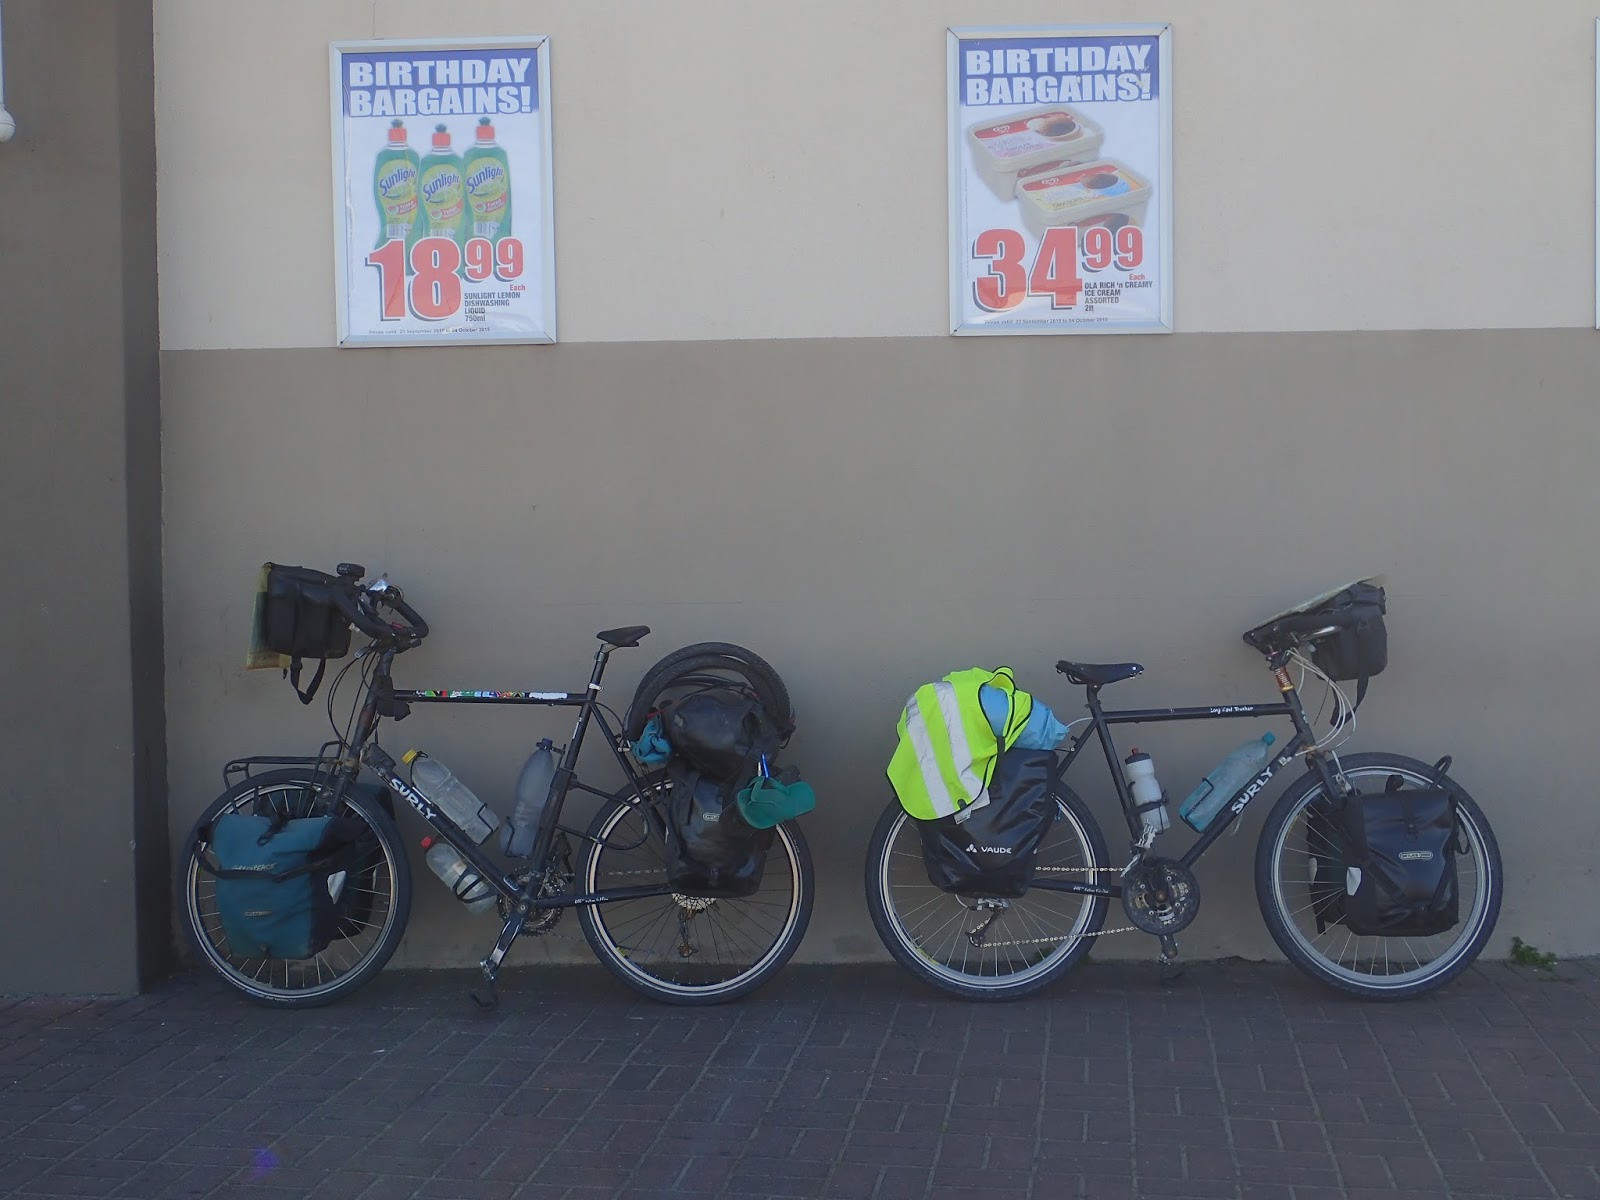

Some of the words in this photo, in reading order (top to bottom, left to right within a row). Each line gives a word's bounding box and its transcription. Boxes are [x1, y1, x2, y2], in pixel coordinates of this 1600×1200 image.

[966, 45, 1151, 75] BIRTHDAY
[350, 58, 531, 87] BIRTHDAY
[966, 73, 1151, 105] BARGAINS!
[350, 86, 533, 117] BARGAINS!
[380, 168, 416, 197] Sunlight
[423, 173, 460, 201] Sunlight
[466, 166, 504, 194] Sunlight
[1084, 282, 1098, 290] OLA
[1099, 281, 1115, 289] RICH
[1124, 280, 1153, 289] CREAMY
[1129, 273, 1146, 281] Each
[464, 292, 496, 300] SUNLIGHT
[497, 291, 521, 299] LEMON
[1084, 289, 1096, 297] ICE
[1097, 289, 1121, 297] CREAM
[1084, 296, 1120, 304] ASSORTED
[464, 299, 510, 307] DISHWASHING
[464, 307, 486, 315] LIQUID
[464, 314, 486, 322] 750ml
[389, 778, 437, 820] SURLY
[1231, 766, 1273, 815] SURLY
[980, 846, 1012, 854] VAUDE
